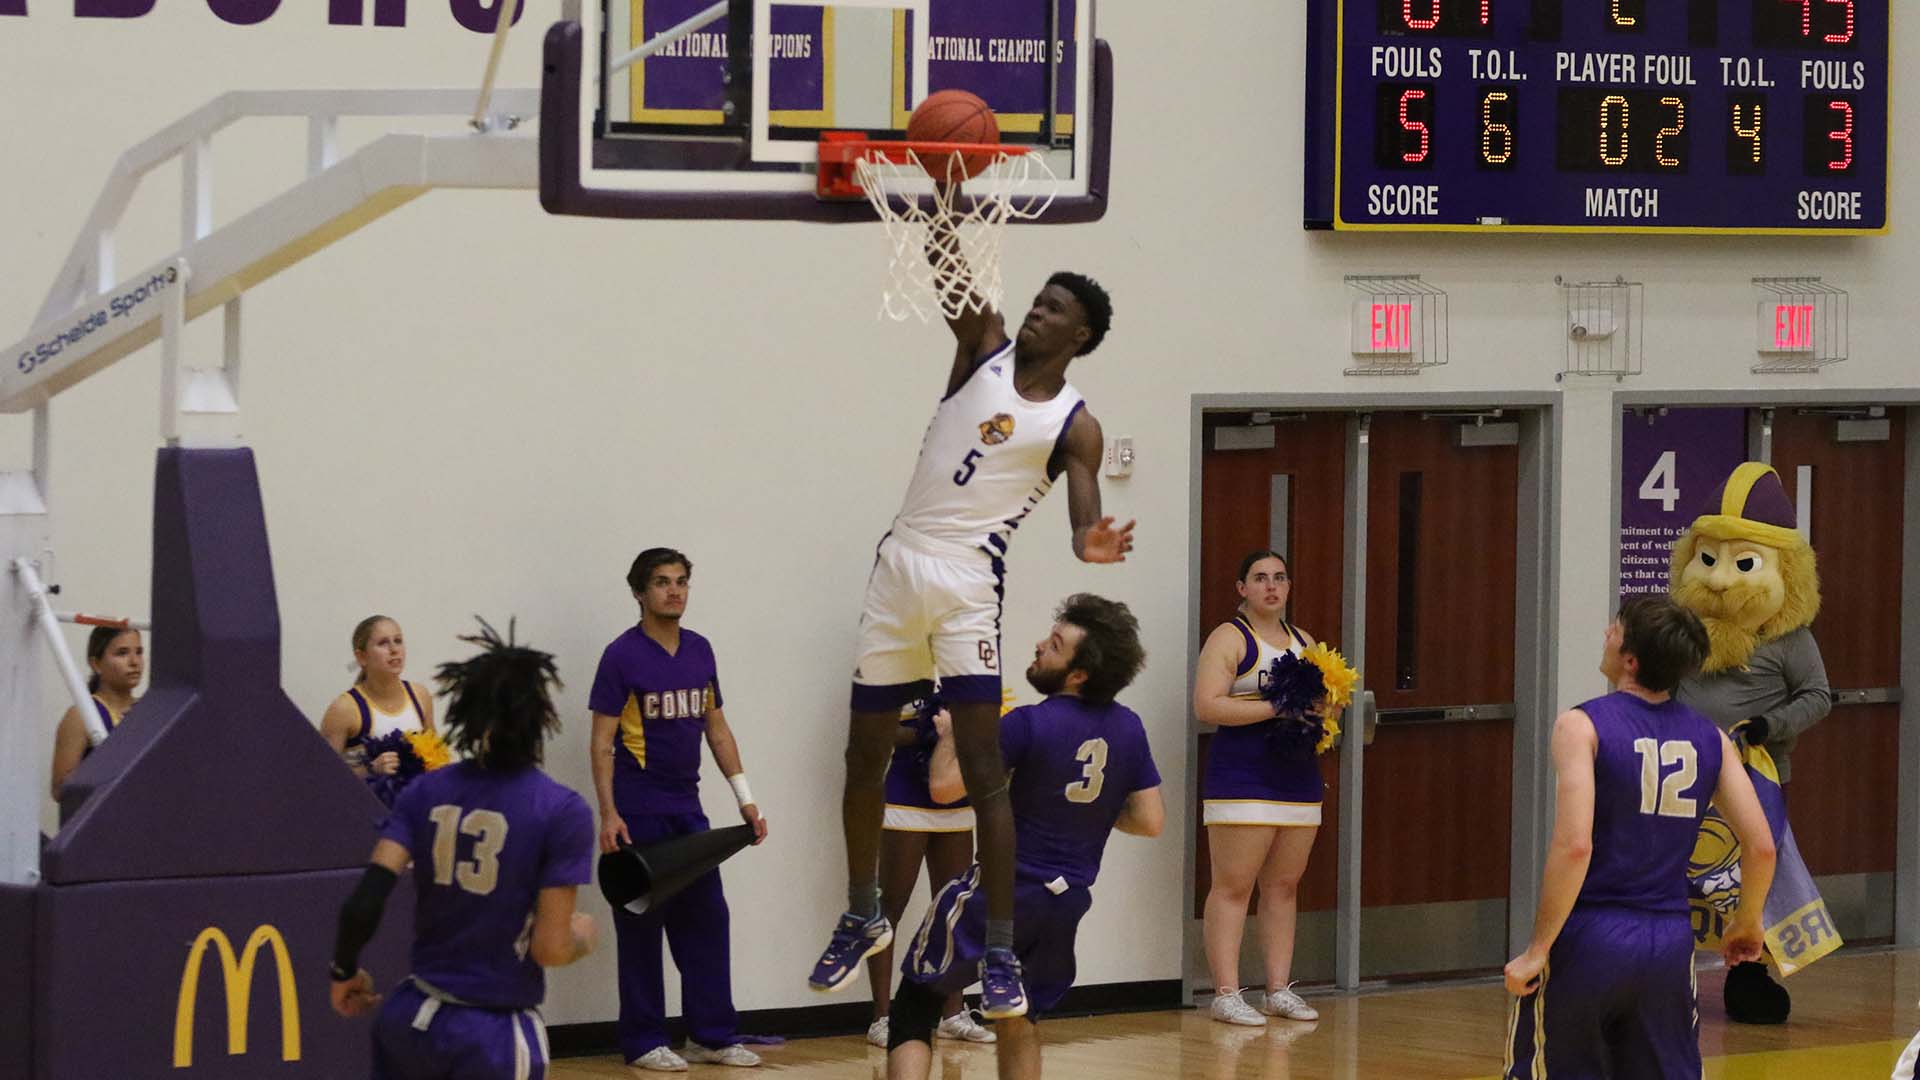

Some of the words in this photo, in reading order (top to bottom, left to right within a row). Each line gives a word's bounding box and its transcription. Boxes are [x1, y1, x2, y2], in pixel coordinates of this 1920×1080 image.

[928, 36, 984, 62] ATIONAL
[988, 38, 1064, 63] CHAMPIOS
[1371, 46, 1442, 78] FOULS
[1468, 49, 1527, 80] T.O.L.
[1556, 52, 1636, 83] PLAYER
[1644, 54, 1696, 85] FOUL
[1719, 57, 1775, 87] T.O.L.
[1801, 60, 1865, 90] FOULS
[1400, 90, 1428, 162] 5
[1483, 92, 1511, 163] 6
[1733, 105, 1761, 162] 4
[1828, 101, 1853, 169] 3
[1367, 184, 1439, 216] SCORE
[1585, 187, 1658, 217] MATCH
[1797, 191, 1862, 220] SCORE
[1371, 303, 1411, 350] EXIT
[1775, 304, 1815, 348] EXIT
[953, 447, 984, 487] 5
[1639, 450, 1680, 512] 4
[1641, 540, 1653, 551] of
[1663, 526, 1674, 536] to
[1622, 554, 1659, 565] citizens
[1635, 569, 1656, 580] that
[1065, 737, 1109, 804] 3
[1633, 737, 1698, 818] 12
[429, 804, 510, 896] 13
